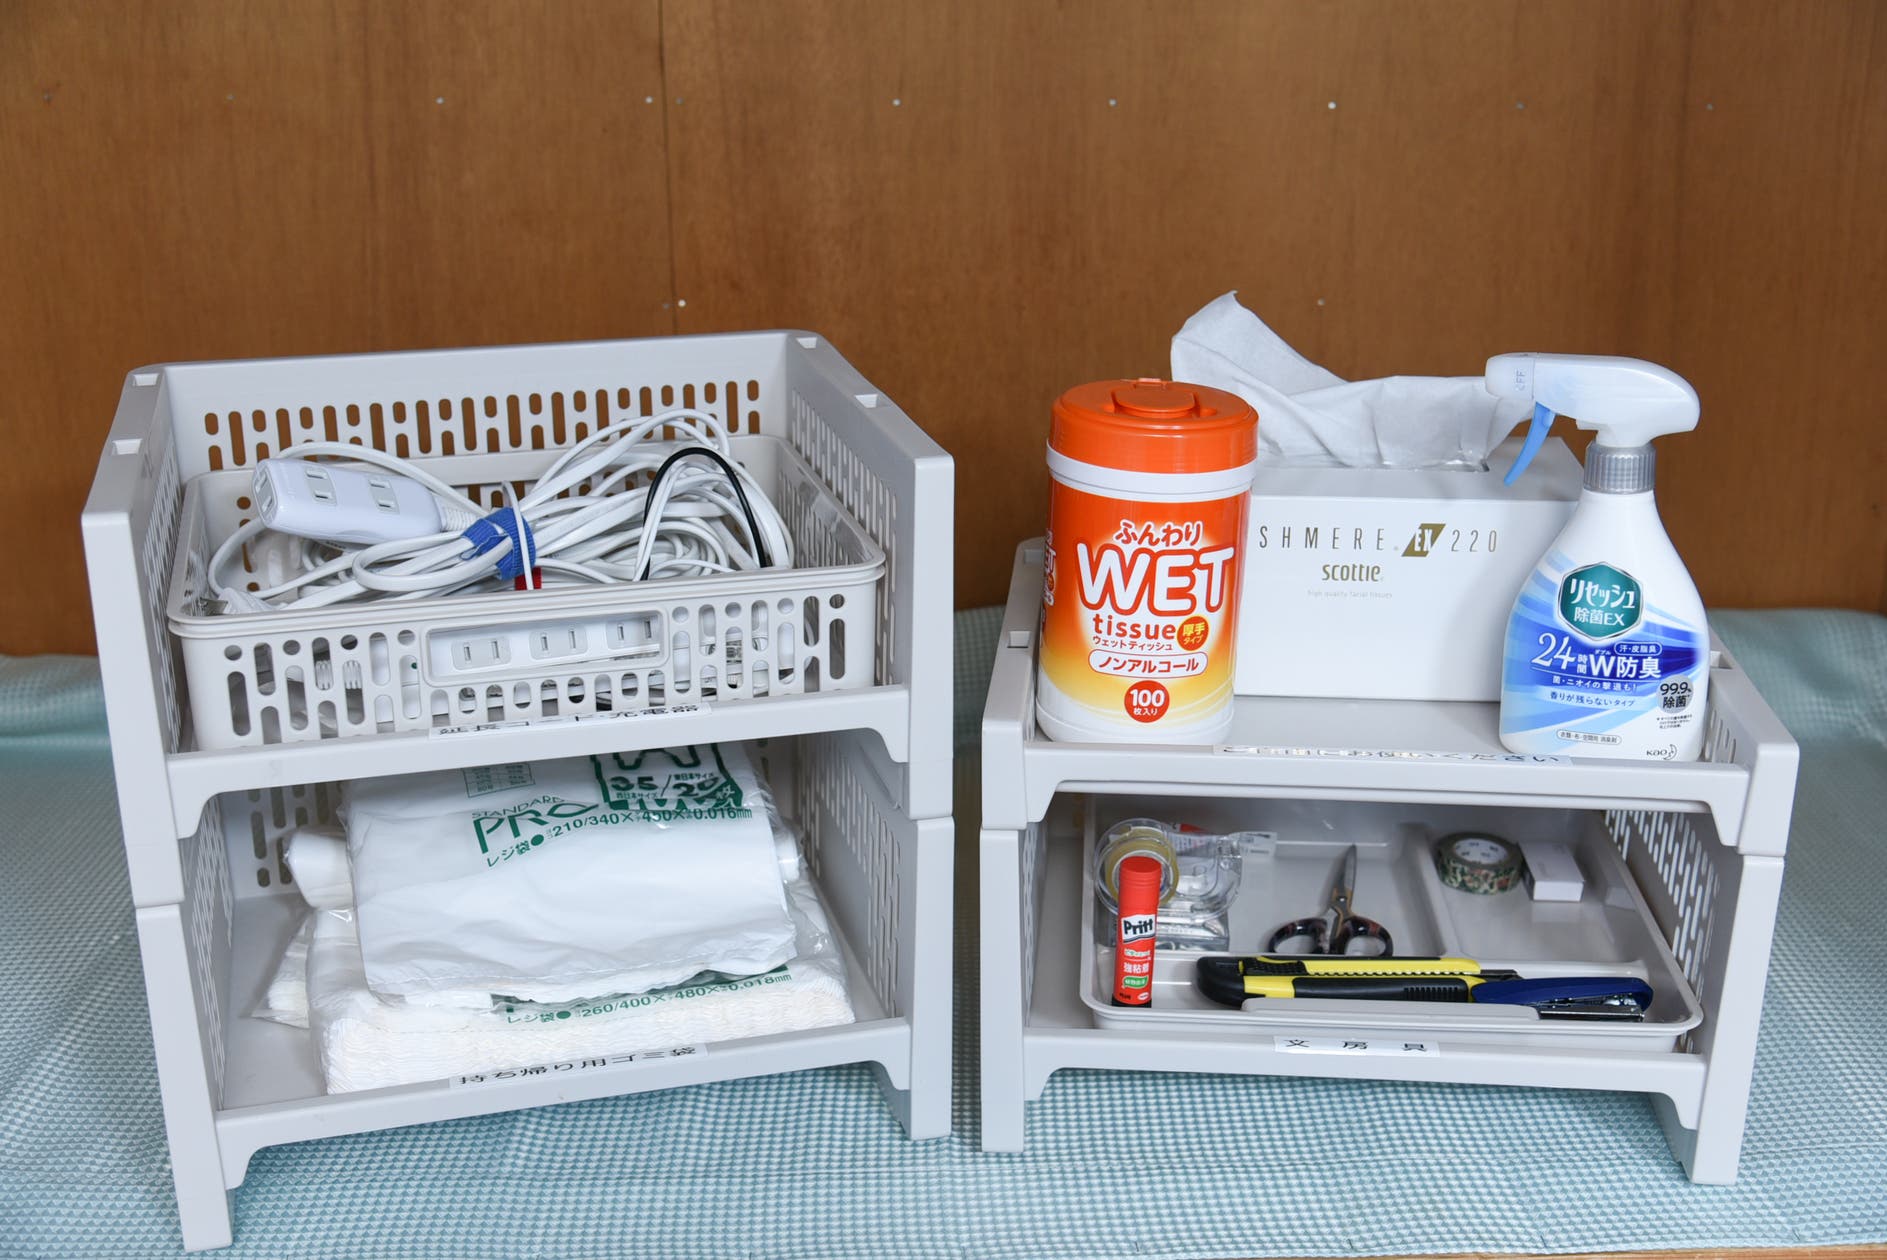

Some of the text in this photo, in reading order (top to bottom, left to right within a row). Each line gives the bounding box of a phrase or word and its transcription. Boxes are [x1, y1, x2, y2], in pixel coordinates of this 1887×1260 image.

[1114, 521, 1203, 547] ふんわり
[1259, 525, 1385, 551] SHMERE
[1450, 529, 1498, 552] 220
[1077, 542, 1235, 614] WET
[1321, 563, 1381, 582] scottie
[1569, 578, 1636, 609] リセッシュ
[1573, 607, 1625, 627] 除菌EX
[1092, 614, 1177, 641] tissue
[1182, 622, 1206, 637] 厚手
[1092, 636, 1174, 651] ウェットティッシュ
[1183, 634, 1204, 645] タイプ
[1099, 655, 1200, 674] ノンアルコール
[1129, 688, 1165, 708] 100
[1550, 692, 1636, 708] 香りが残らないタイプ
[1133, 706, 1159, 717] 枚入り
[471, 795, 565, 818] STANDARD
[487, 841, 531, 868] レジ袋
[1123, 919, 1154, 936] Pritt
[507, 1010, 555, 1024] レジ袋
[459, 1046, 697, 1084] 持ち帰り用ゴミ袋
